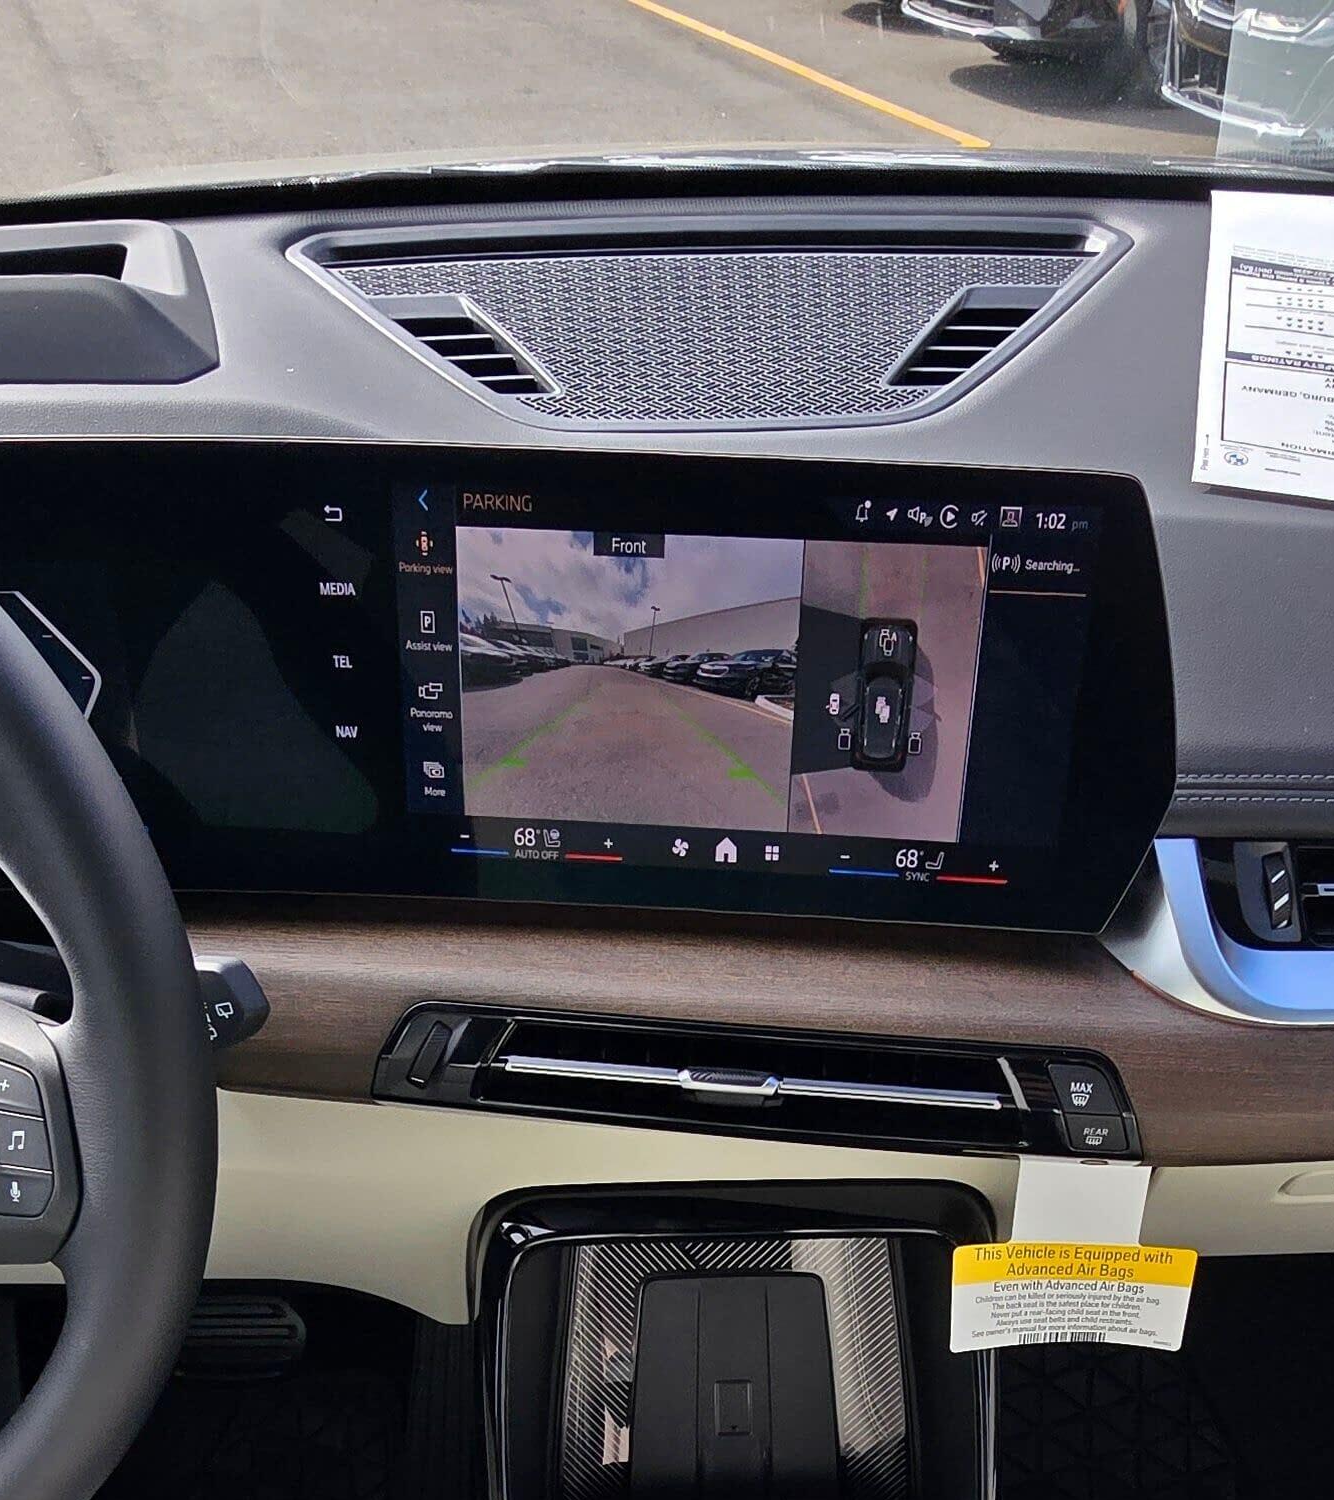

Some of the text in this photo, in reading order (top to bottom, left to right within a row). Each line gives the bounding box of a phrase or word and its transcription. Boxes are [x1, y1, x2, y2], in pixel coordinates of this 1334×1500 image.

[1241, 385, 1298, 399] GERMANY
[463, 493, 533, 513] PARKING
[1035, 512, 1067, 531] 1:02
[611, 537, 647, 554] Front
[398, 561, 453, 576] Parking view
[319, 582, 356, 597] MEDIA
[405, 640, 453, 653] Assist view
[332, 655, 353, 670] TEL
[409, 707, 454, 721] Panorama
[334, 725, 358, 739] NAV
[422, 721, 443, 733] view
[424, 786, 446, 798] More
[514, 849, 559, 861] AUTO OFF
[905, 871, 930, 883] SYNC
[1070, 1082, 1093, 1094] MAX
[1083, 1127, 1109, 1137] REAR
[974, 1246, 1173, 1265] This Vehicle is Equipped with
[1006, 1262, 1134, 1281] Advanced Air Bags
[993, 1279, 1145, 1296] Even with Advanced Air Bags
[975, 1295, 1004, 1304] Children
[1027, 1292, 1047, 1300] killed
[1056, 1293, 1087, 1302] seriously
[1087, 1293, 1112, 1302] injured
[1123, 1295, 1135, 1303] the
[991, 1302, 1005, 1311] The
[1005, 1301, 1022, 1309] back
[1058, 1299, 1079, 1308] safest
[1080, 1301, 1100, 1309] place
[990, 1311, 1011, 1319] Never
[1011, 1310, 1023, 1318] put
[1029, 1308, 1066, 1317] rear-facing
[995, 1319, 1019, 1327] Always
[1032, 1316, 1048, 1324] seat
[971, 1330, 985, 1338] See
[1011, 1325, 1037, 1333] manual
[1067, 1323, 1107, 1331] information
[1107, 1325, 1128, 1333] about
